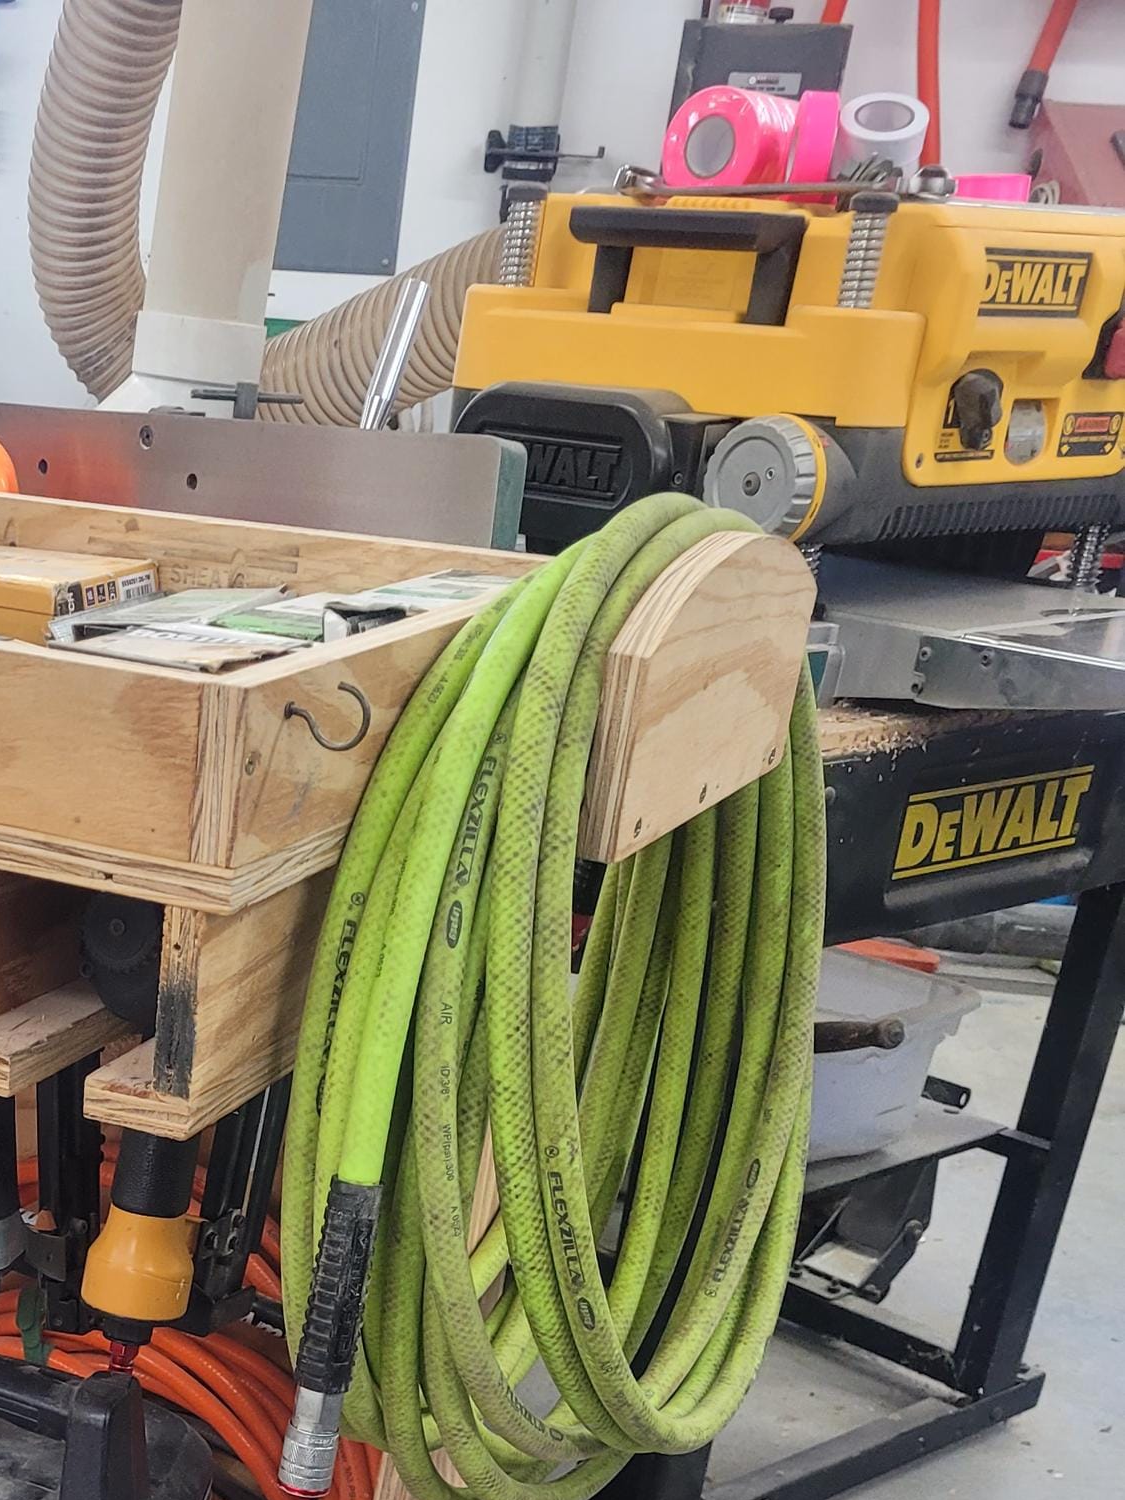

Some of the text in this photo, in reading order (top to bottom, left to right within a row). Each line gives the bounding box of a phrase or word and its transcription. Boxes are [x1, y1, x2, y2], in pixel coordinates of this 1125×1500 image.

[979, 260, 1088, 306] DEWALT
[525, 443, 620, 491] WALT
[455, 755, 497, 887] FLEXZILLA
[894, 773, 1093, 870] DEWALT
[440, 1001, 453, 1026] AIR
[548, 1170, 585, 1288] FLEXZILLA
